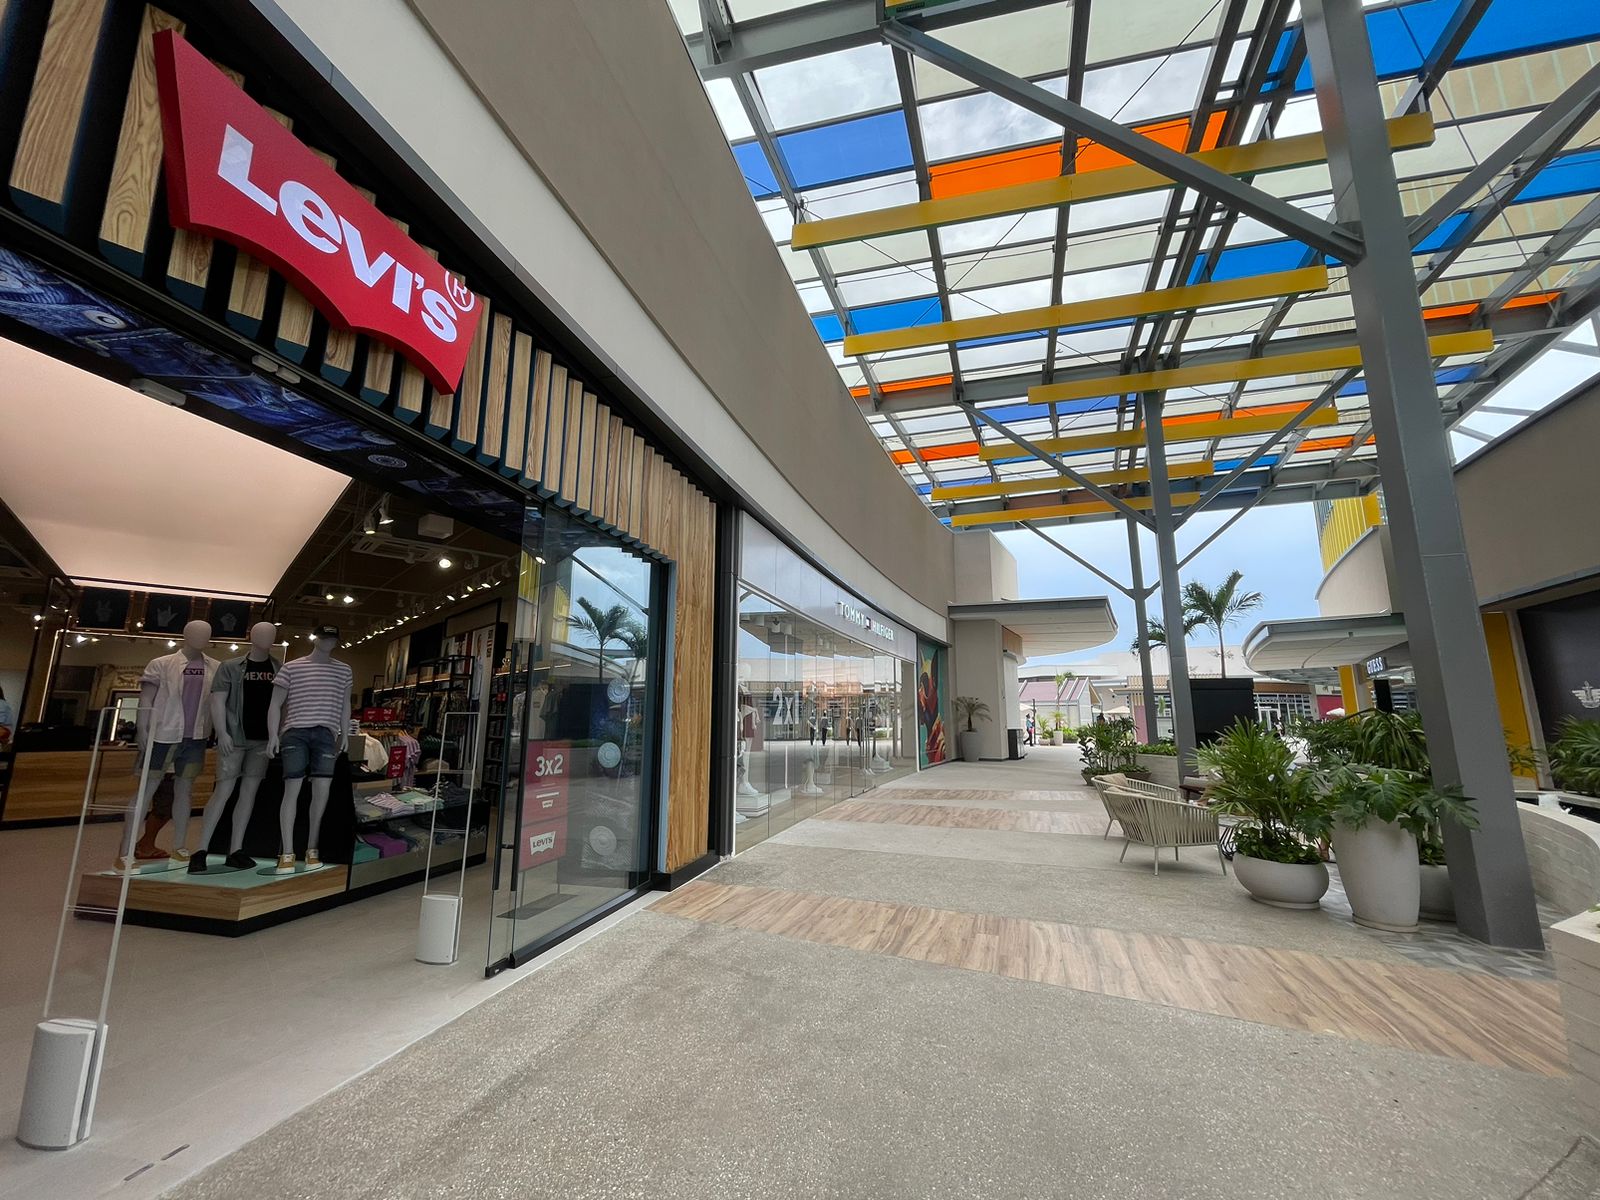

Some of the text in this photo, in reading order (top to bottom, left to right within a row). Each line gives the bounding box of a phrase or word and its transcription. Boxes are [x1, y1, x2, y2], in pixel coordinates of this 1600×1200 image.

[840, 600, 865, 626] TOMMY
[1366, 656, 1384, 675] GUESS
[535, 754, 564, 777] 3x2
